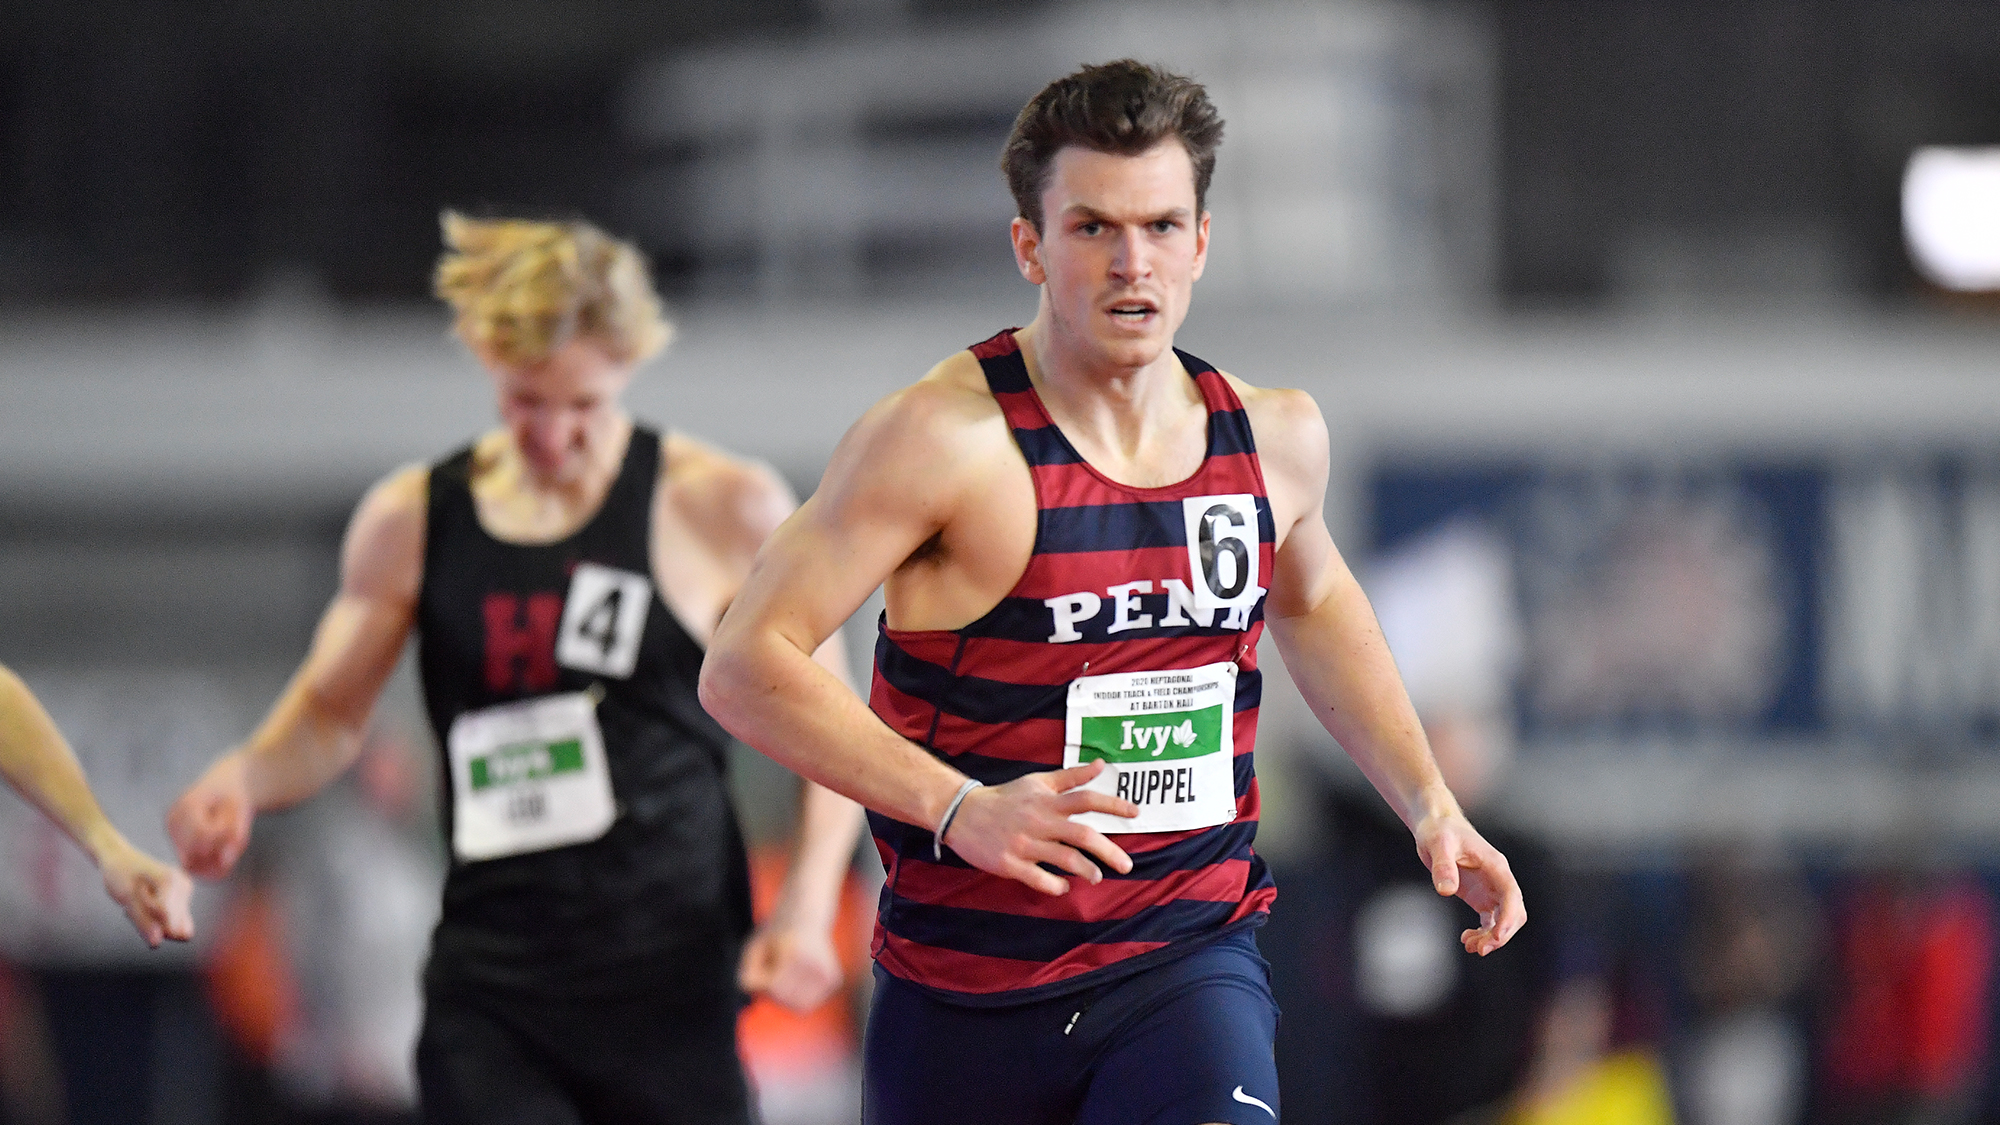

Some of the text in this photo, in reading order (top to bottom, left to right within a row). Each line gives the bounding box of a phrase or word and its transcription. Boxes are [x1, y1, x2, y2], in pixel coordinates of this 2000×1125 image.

[1199, 503, 1249, 599] 6
[484, 591, 562, 691] H
[578, 588, 622, 660] 4
[1094, 690, 1122, 700] INDOOR
[1123, 689, 1146, 699] TRACK
[1153, 688, 1172, 697] FIELD
[1131, 677, 1149, 687] 2020
[1130, 698, 1194, 711] AT BARTON HALL
[1120, 720, 1172, 757] Ivy
[1117, 767, 1196, 806] RUPPEL
